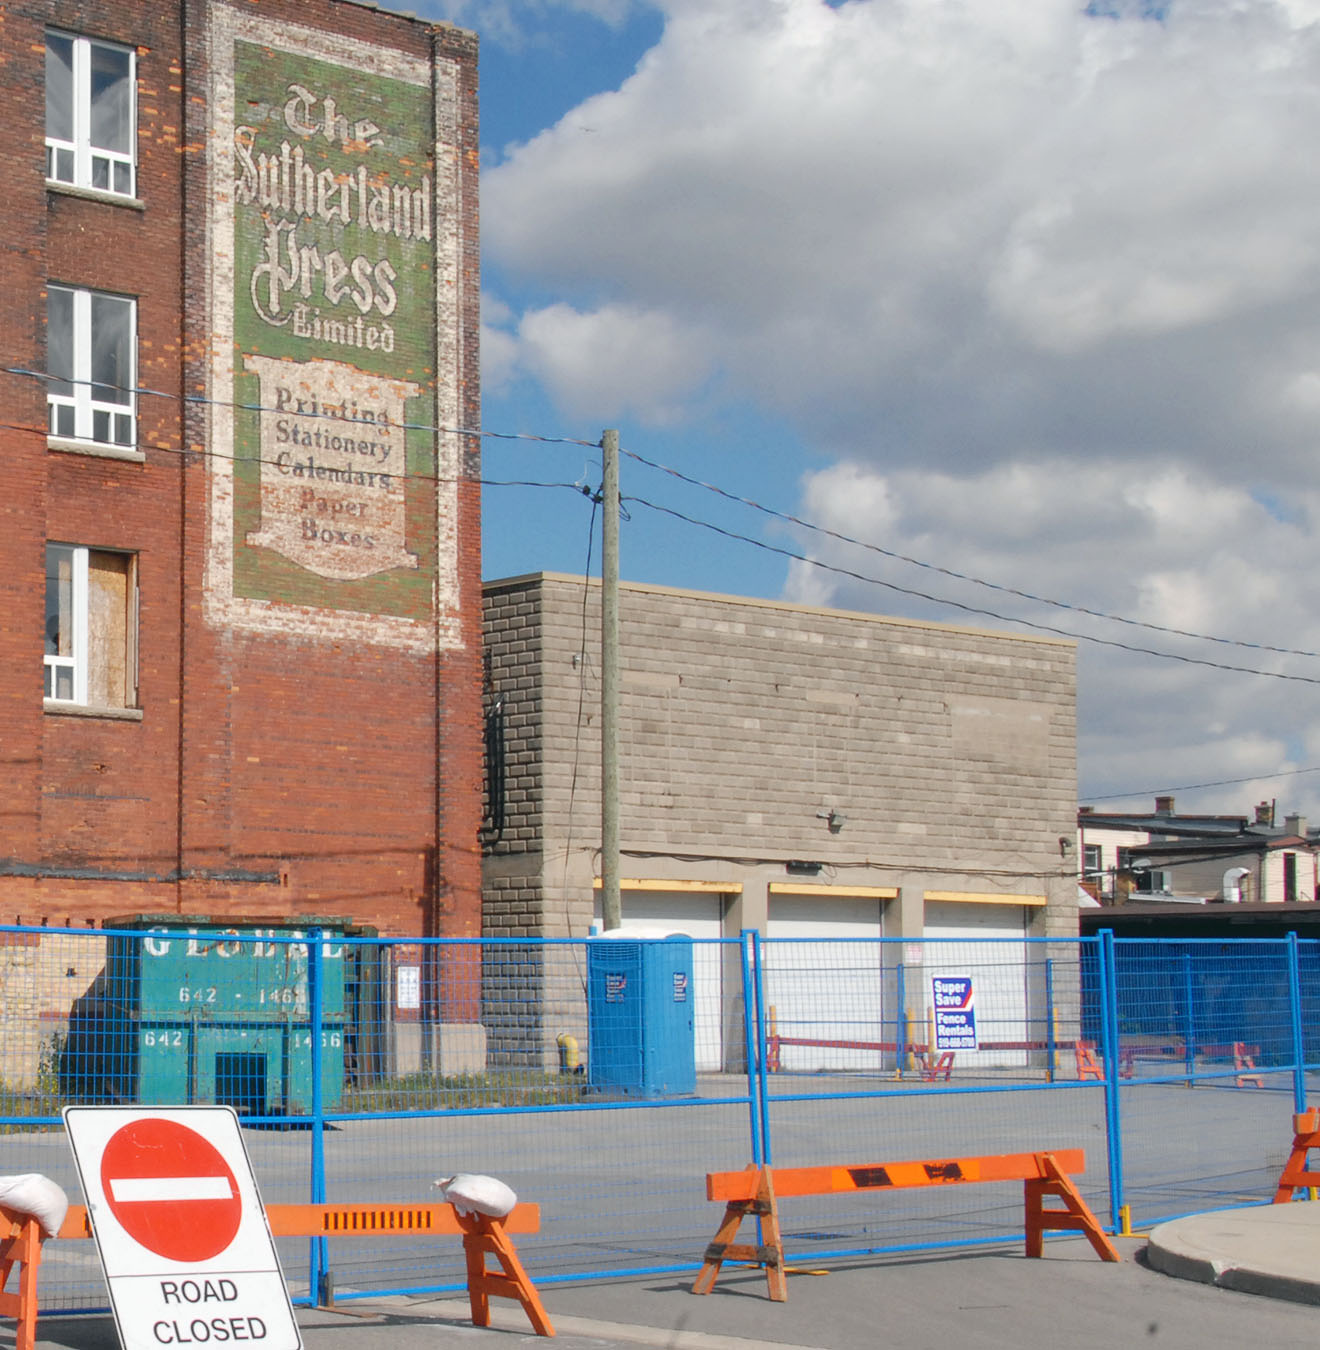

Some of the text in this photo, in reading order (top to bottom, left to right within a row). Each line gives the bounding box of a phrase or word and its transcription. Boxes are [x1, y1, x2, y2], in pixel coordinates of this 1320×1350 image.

[284, 83, 384, 146] The
[234, 125, 431, 242] Sutherland
[251, 215, 398, 326] Press
[293, 302, 394, 353] Limited
[275, 386, 391, 436] Printing
[276, 419, 393, 463] Stationery
[277, 451, 392, 490] Calendars
[300, 488, 368, 520] Paper
[301, 518, 376, 548] Boxes
[179, 986, 217, 1003] 642
[934, 980, 966, 995] Super
[936, 993, 962, 1005] Save
[937, 1013, 966, 1024] Fence
[938, 1025, 974, 1036] Rentals
[144, 1031, 183, 1047] 642
[160, 1279, 239, 1304] ROAD
[153, 1317, 267, 1344] CLOSED
